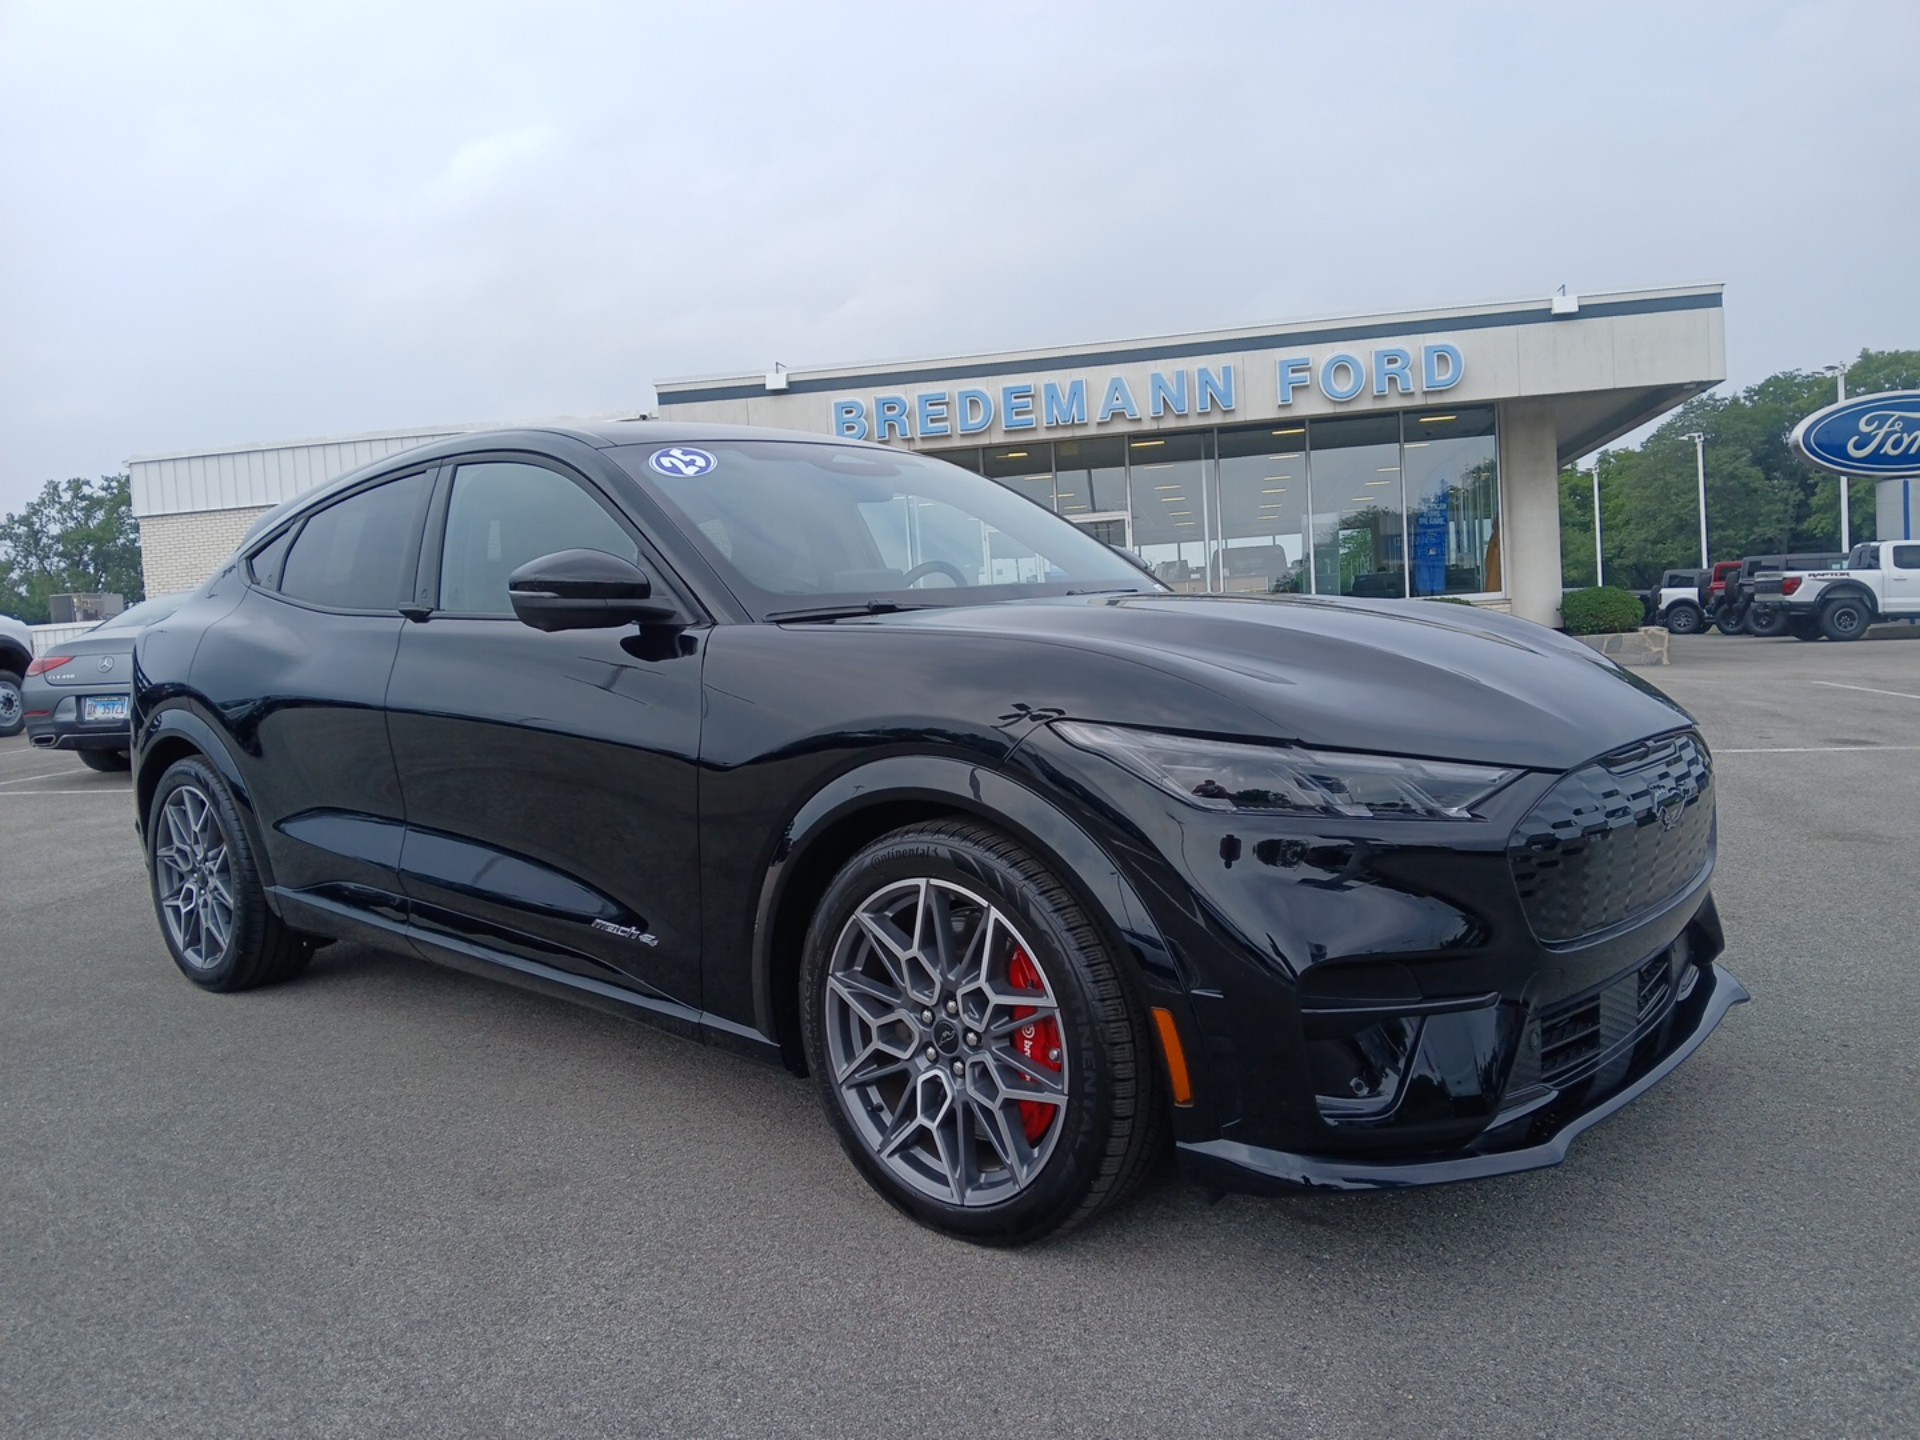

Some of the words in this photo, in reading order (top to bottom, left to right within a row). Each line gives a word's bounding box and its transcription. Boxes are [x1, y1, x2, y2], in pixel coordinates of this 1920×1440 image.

[833, 364, 1236, 440] BREDEMANN
[1277, 342, 1465, 406] FORD
[660, 448, 706, 475] 25
